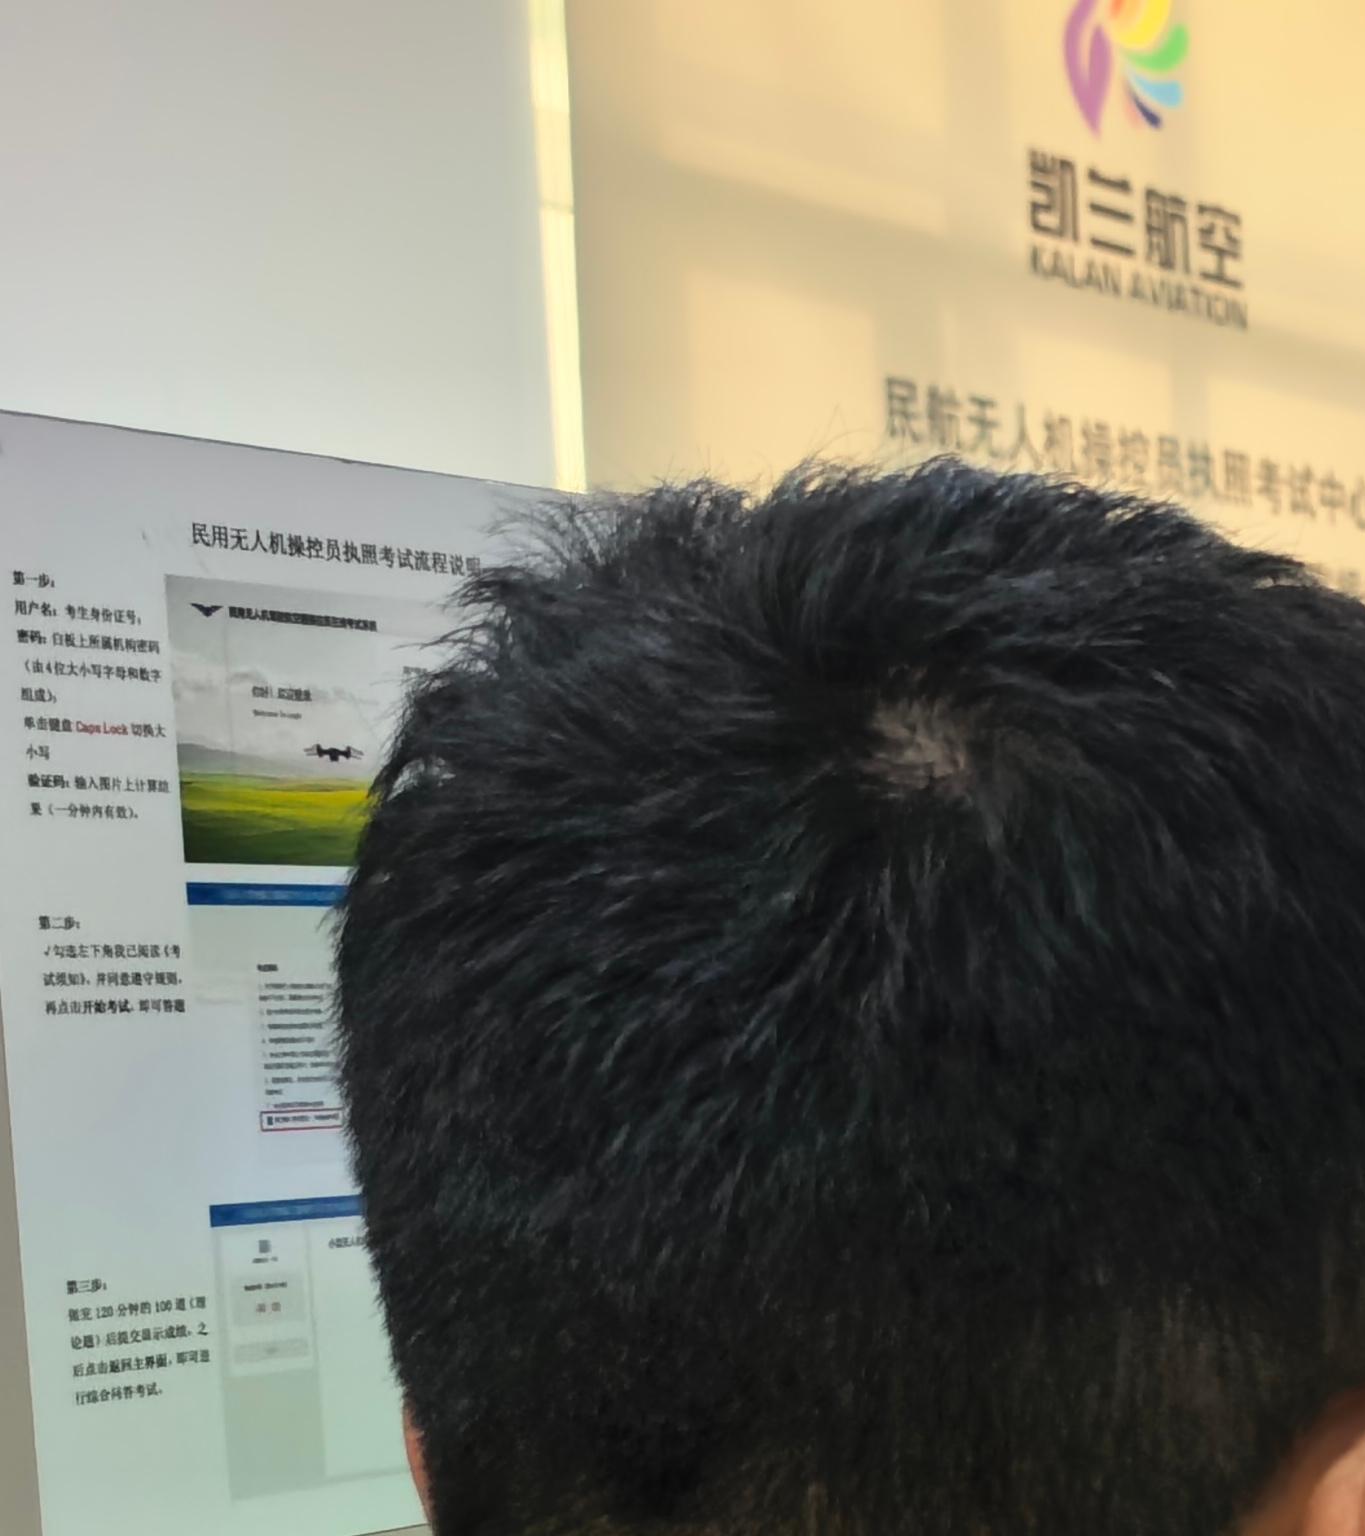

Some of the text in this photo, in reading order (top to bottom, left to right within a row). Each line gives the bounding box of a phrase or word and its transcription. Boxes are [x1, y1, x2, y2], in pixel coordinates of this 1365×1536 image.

[1029, 149, 1243, 289] 凯兰航空
[1031, 246, 1248, 330] KALAN AVIATION
